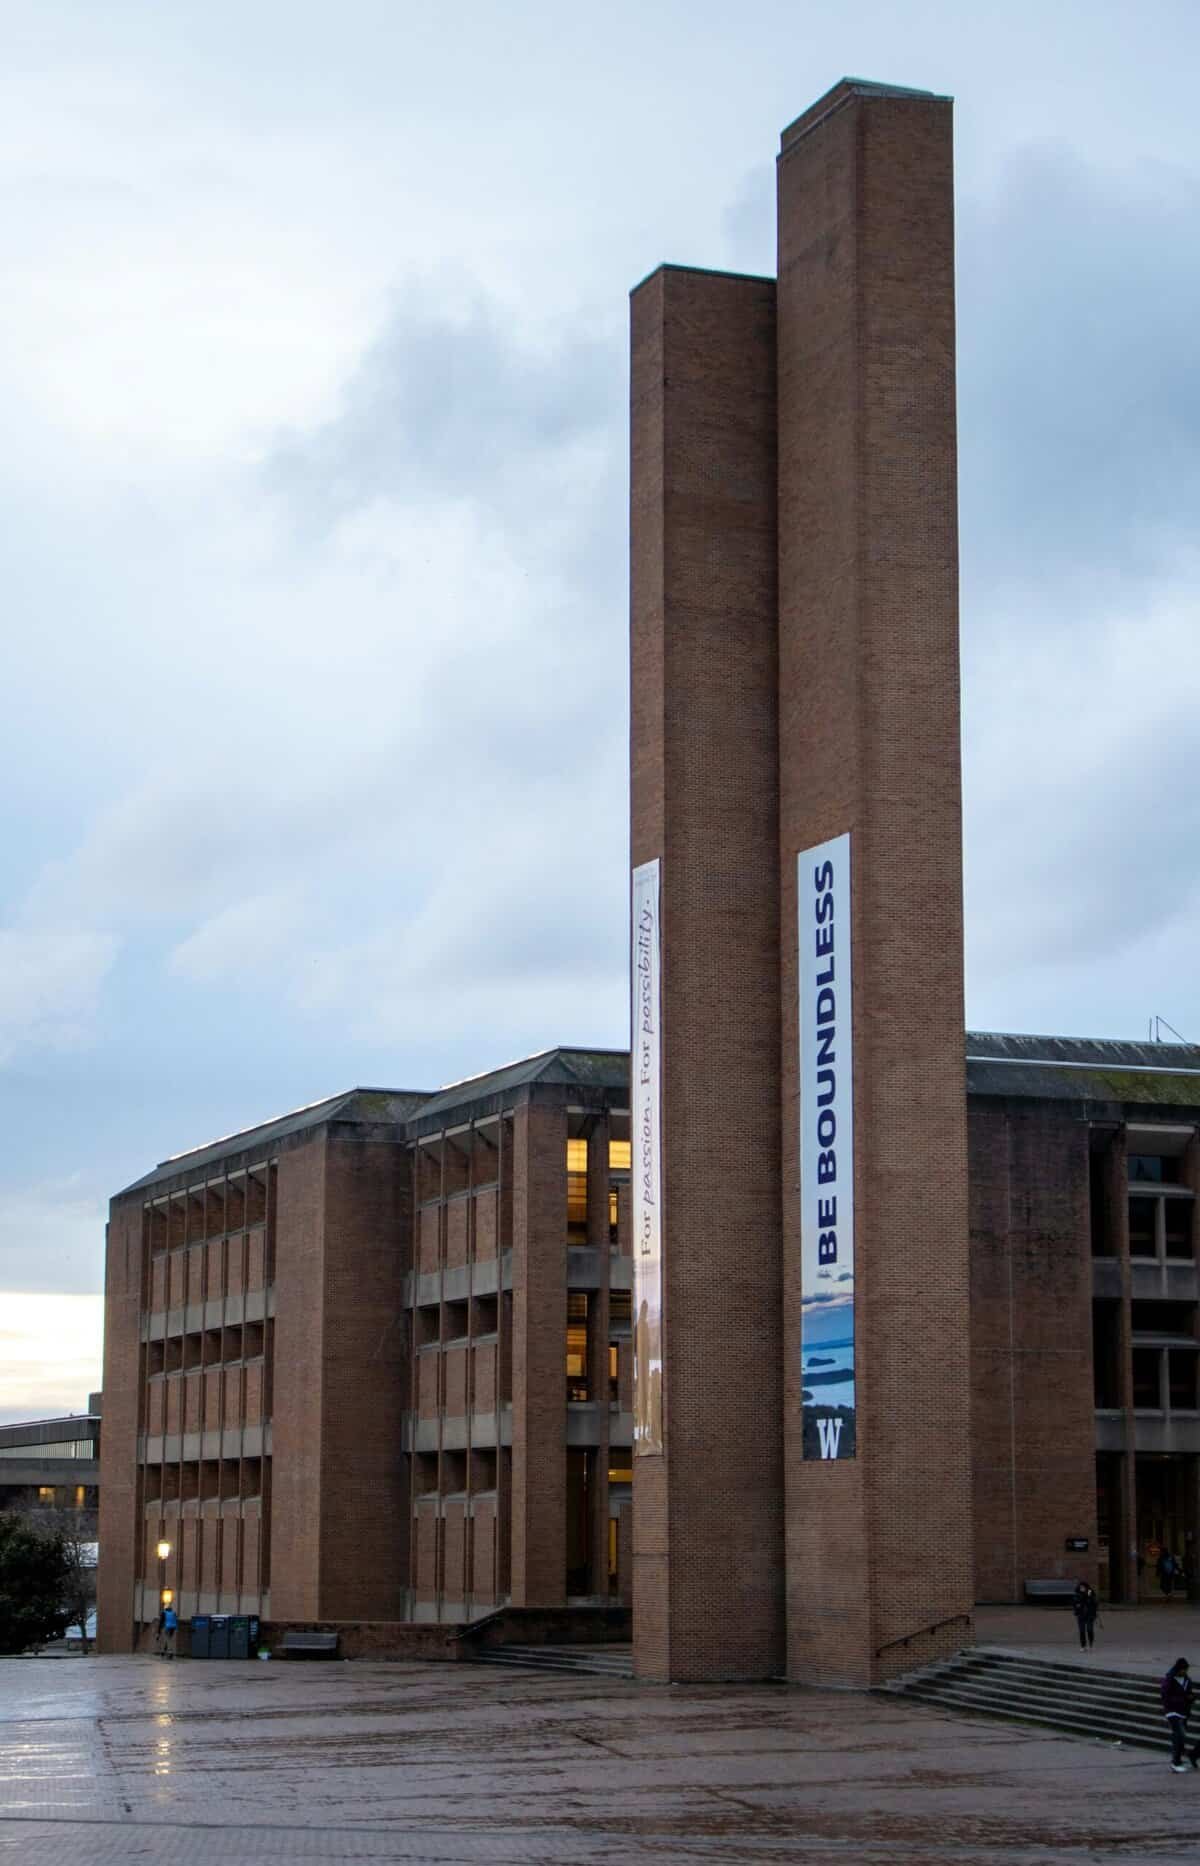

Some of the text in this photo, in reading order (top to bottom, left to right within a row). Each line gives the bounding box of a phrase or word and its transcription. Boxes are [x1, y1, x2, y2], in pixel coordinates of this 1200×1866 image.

[638, 898, 655, 1035] possibility.
[640, 1040, 651, 1086] For
[815, 860, 838, 1266] BE BOUNDLESS
[641, 1096, 655, 1206] passion.
[640, 1211, 651, 1257] For
[816, 1417, 844, 1460] W
